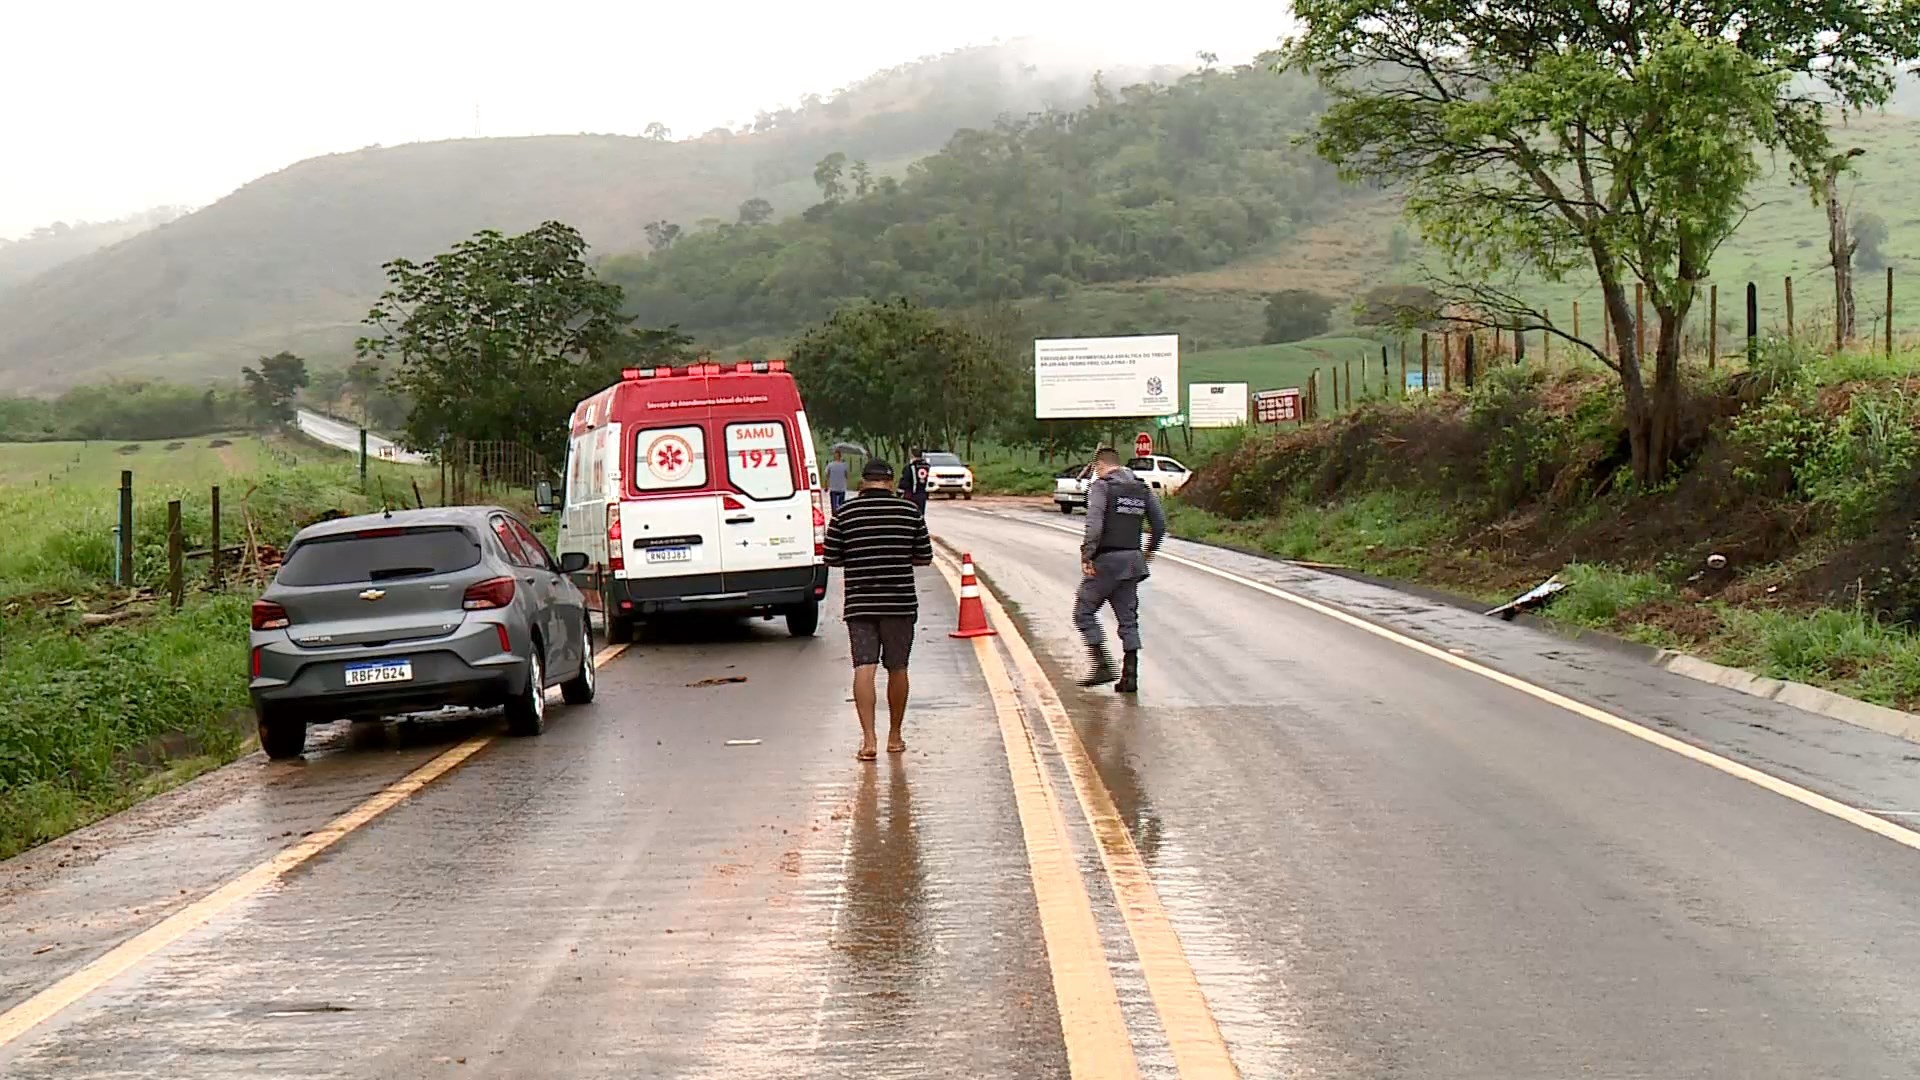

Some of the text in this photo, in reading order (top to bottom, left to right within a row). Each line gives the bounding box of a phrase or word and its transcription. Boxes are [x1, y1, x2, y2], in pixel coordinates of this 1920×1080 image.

[678, 399, 715, 407] Atendimento
[743, 394, 768, 404] Urgência
[735, 427, 774, 440] SAMU
[1135, 442, 1151, 452] PARE
[738, 447, 778, 469] 192
[351, 667, 405, 683] RBF7G24
